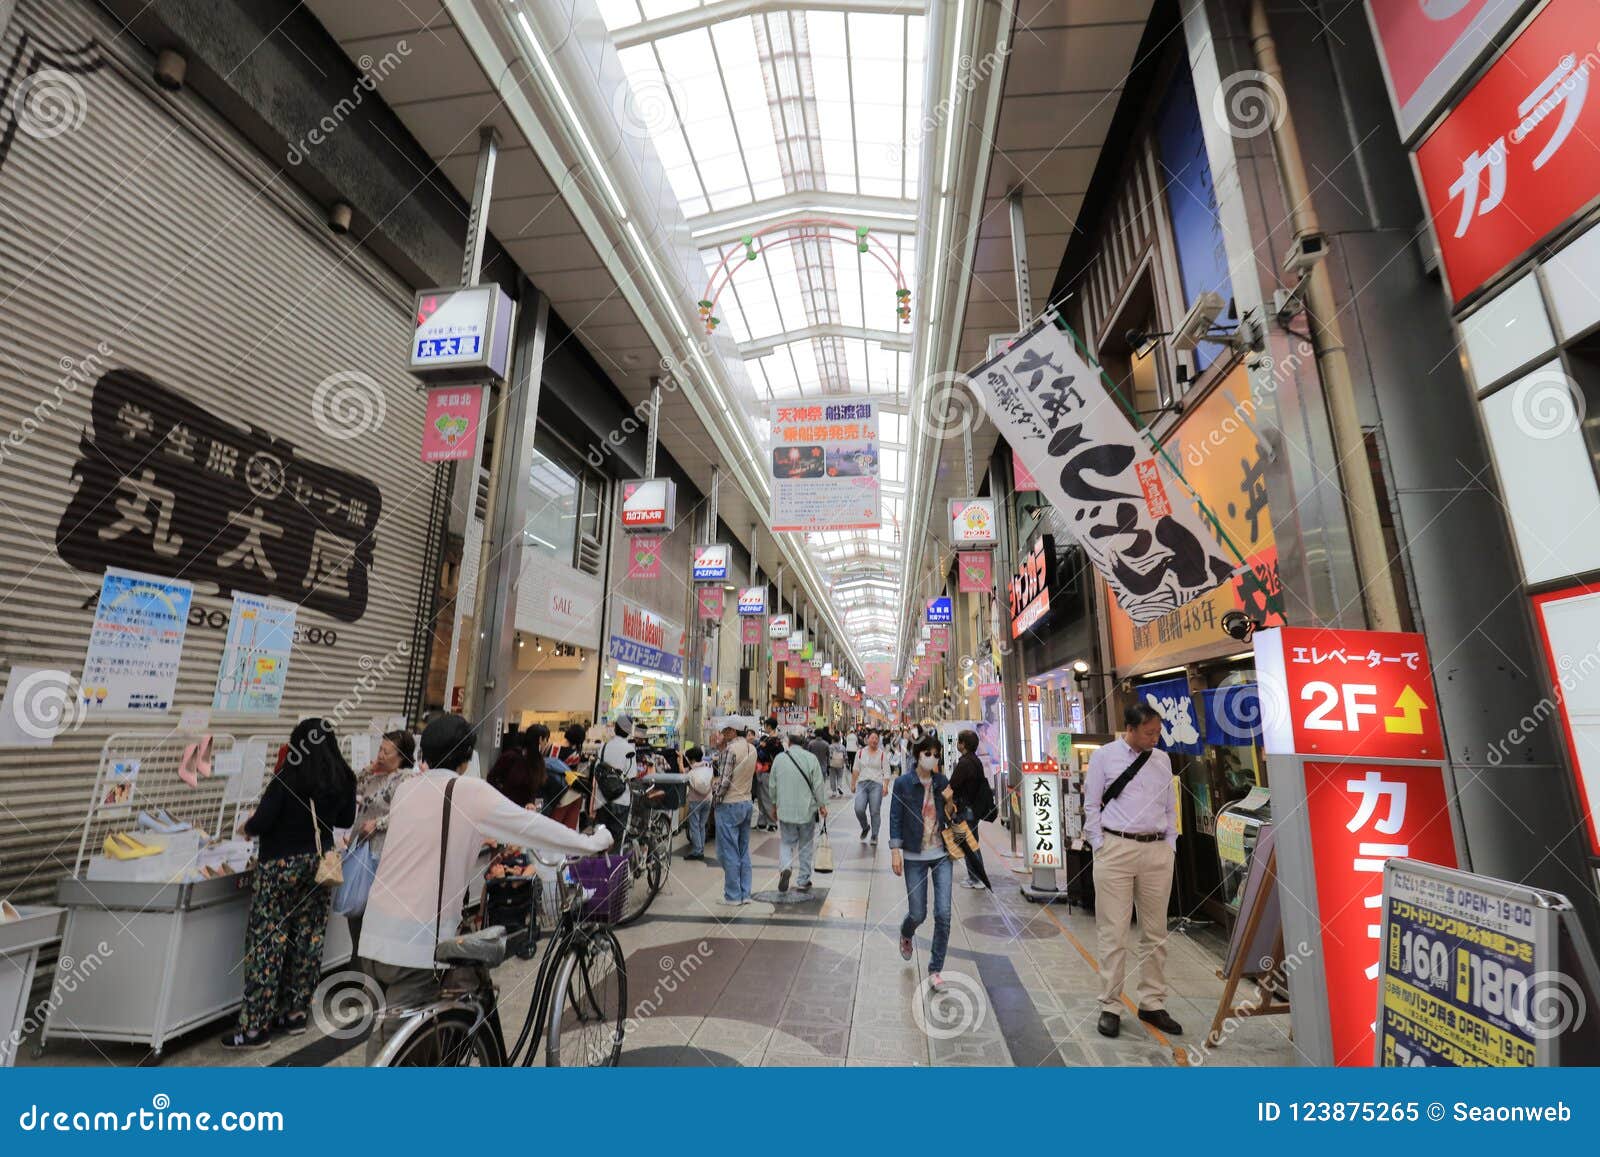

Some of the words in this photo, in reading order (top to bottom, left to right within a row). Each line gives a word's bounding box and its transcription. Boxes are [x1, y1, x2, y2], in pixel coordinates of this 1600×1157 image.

[1448, 52, 1590, 238] カラ
[777, 406, 823, 422] 天神祭
[825, 403, 871, 421] 船渡御
[117, 403, 239, 478] 学生服
[292, 477, 368, 527] セーラー服
[98, 470, 358, 598] 丸太屋
[553, 596, 573, 616] SALE
[1158, 597, 1218, 643] 昭和48年
[1292, 647, 1420, 672] エレベーターで
[1300, 680, 1378, 732] 2F
[1033, 777, 1054, 851] 大阪うどん
[1392, 899, 1534, 963] ソフトドリンク飲み放題つき
[1402, 930, 1449, 982] 160
[1469, 953, 1528, 1028] 180
